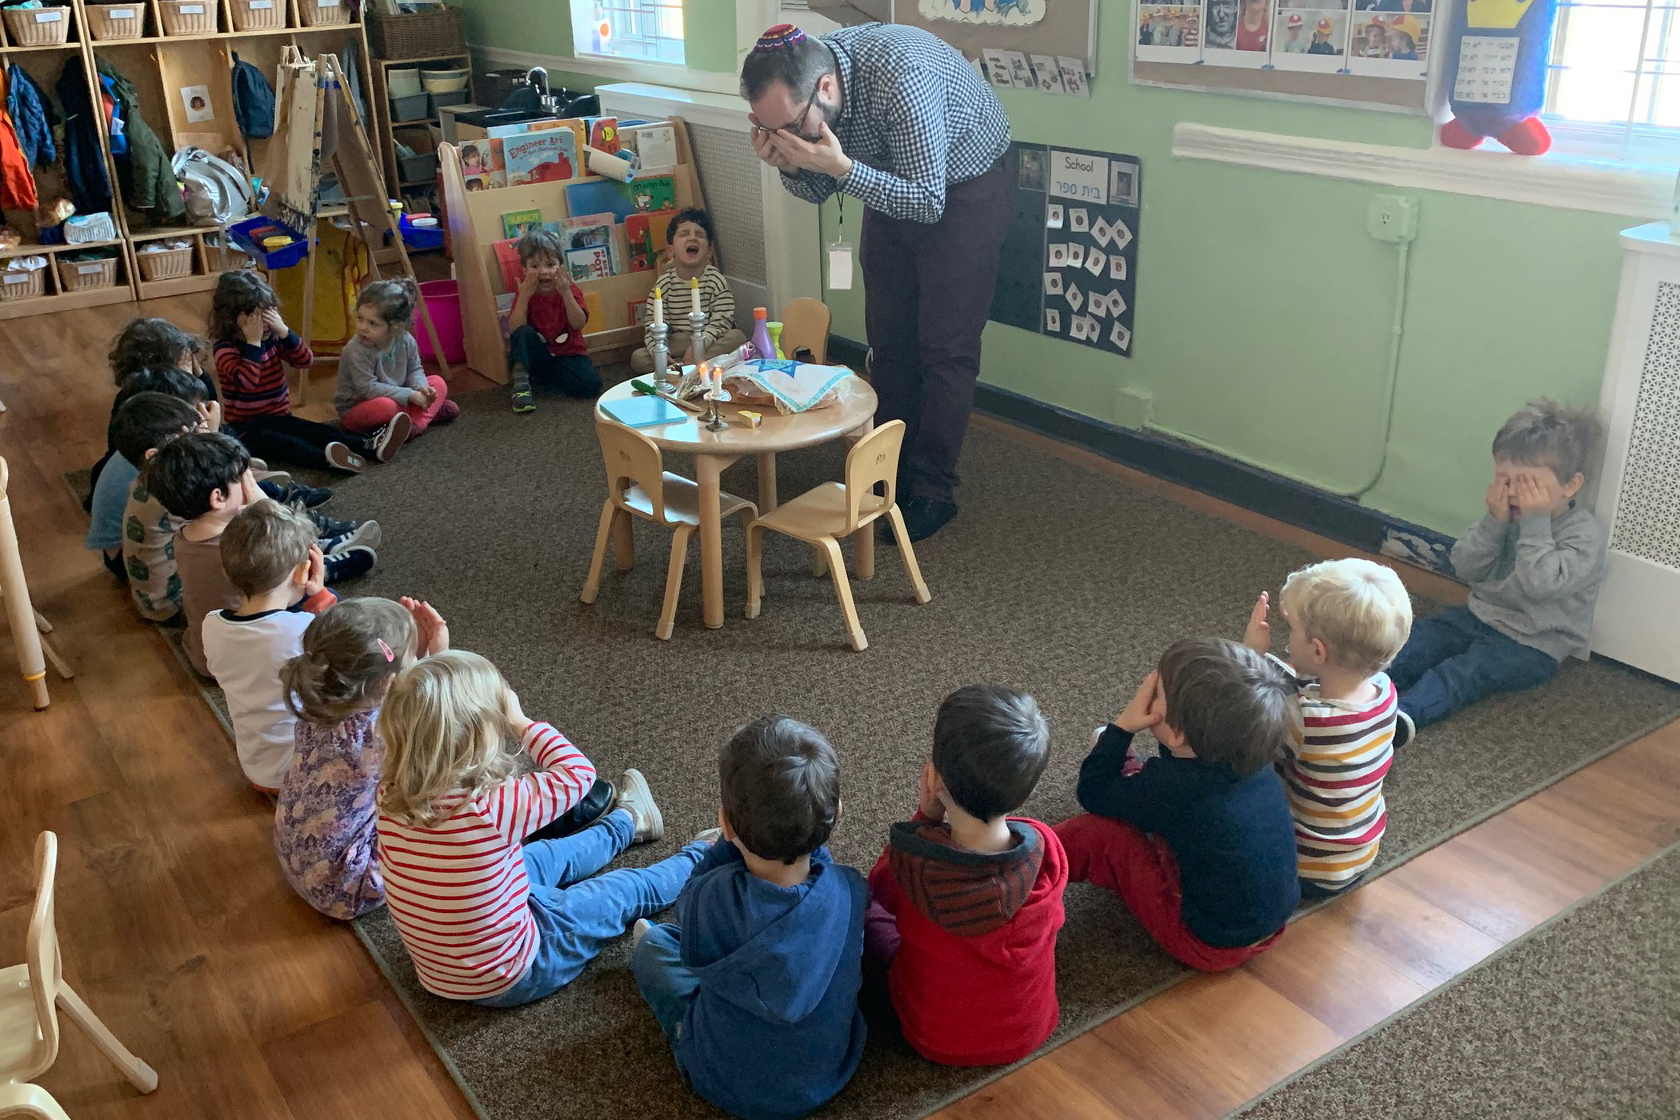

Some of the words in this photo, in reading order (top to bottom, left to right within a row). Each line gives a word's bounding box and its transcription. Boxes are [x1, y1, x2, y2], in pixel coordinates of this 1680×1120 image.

[508, 140, 547, 158] Engineer
[550, 136, 563, 146] Ari
[1065, 156, 1094, 172] School
[1056, 180, 1078, 195] ספר
[1082, 185, 1101, 200] בית
